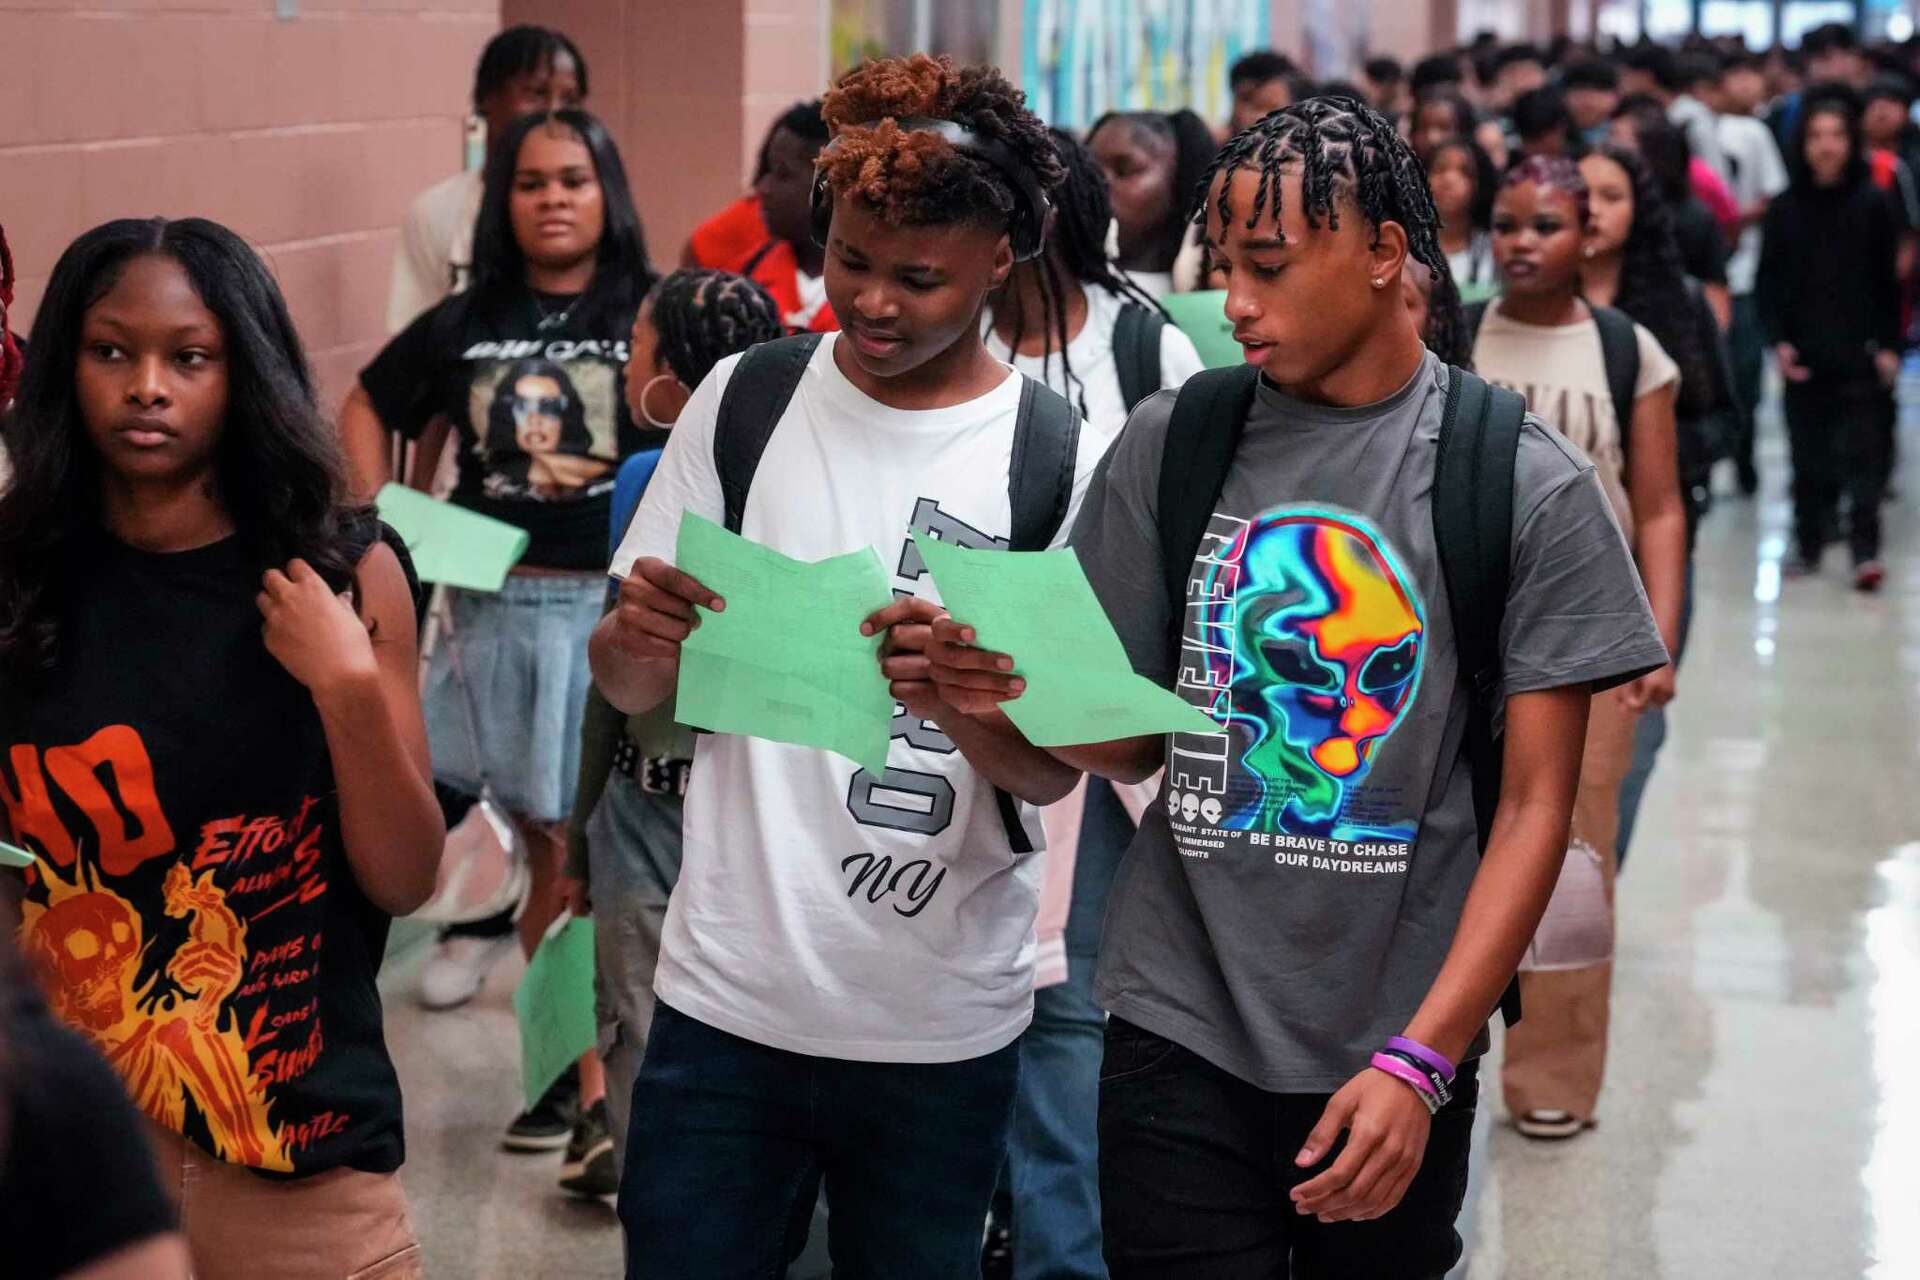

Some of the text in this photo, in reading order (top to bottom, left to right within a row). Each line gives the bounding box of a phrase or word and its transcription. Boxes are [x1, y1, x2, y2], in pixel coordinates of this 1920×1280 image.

[1182, 836, 1225, 848] IMMERSED
[1201, 828, 1228, 838] STATE
[1230, 831, 1242, 839] OF
[1250, 832, 1408, 856] BE BRAVE TO CHASE
[1178, 848, 1209, 859] OUGHTS
[1274, 852, 1407, 874] OUR DAYDREAMS
[841, 852, 947, 918] NY
